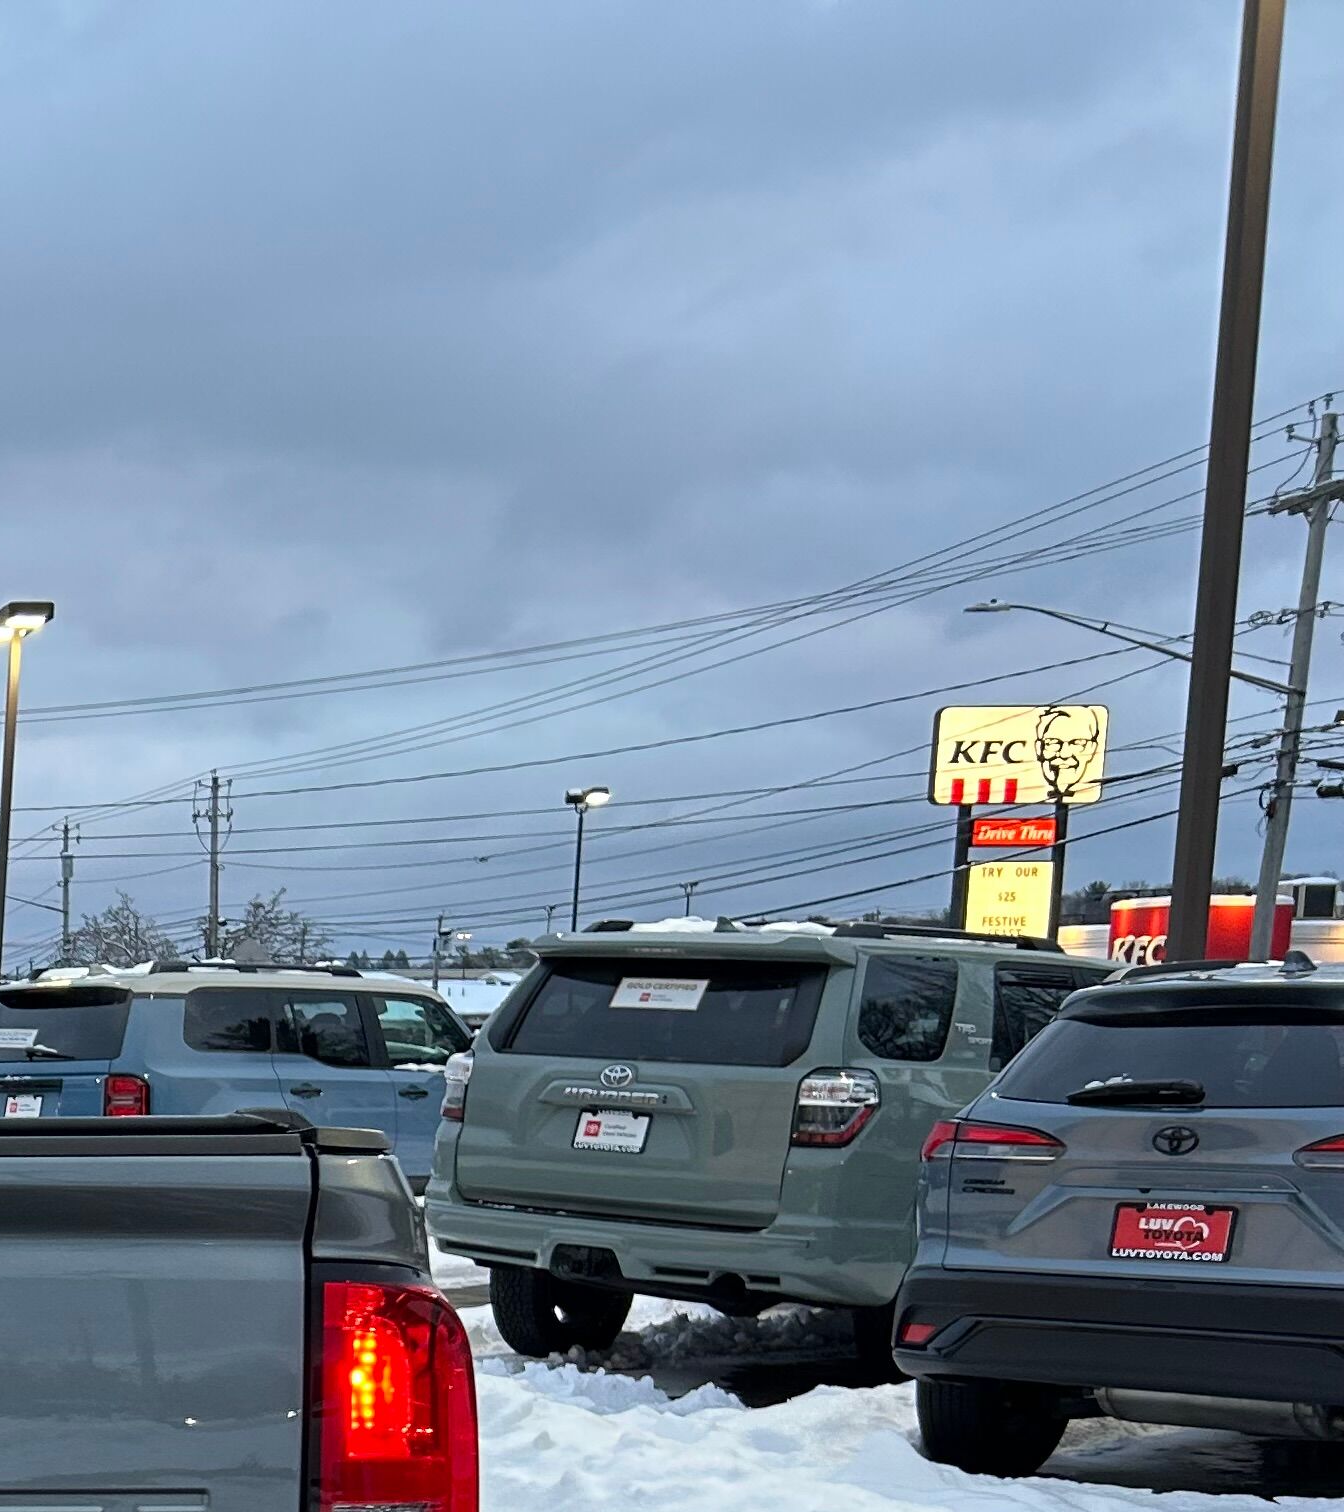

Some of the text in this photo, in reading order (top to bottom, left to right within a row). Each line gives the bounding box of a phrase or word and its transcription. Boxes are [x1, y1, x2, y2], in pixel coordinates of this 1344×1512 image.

[949, 740, 1027, 764] KFC
[977, 825, 1053, 841] Drive Thru
[981, 867, 1038, 878] TRY OUR
[998, 891, 1016, 902] $25
[982, 916, 1027, 927] FESTIVE
[1112, 935, 1168, 966] KFC
[1146, 1202, 1205, 1211] LAKEWOOD
[1138, 1217, 1176, 1230] LUV
[1143, 1229, 1204, 1243] TOYOTA
[1112, 1248, 1223, 1262] LUVTOYOTA.COM
